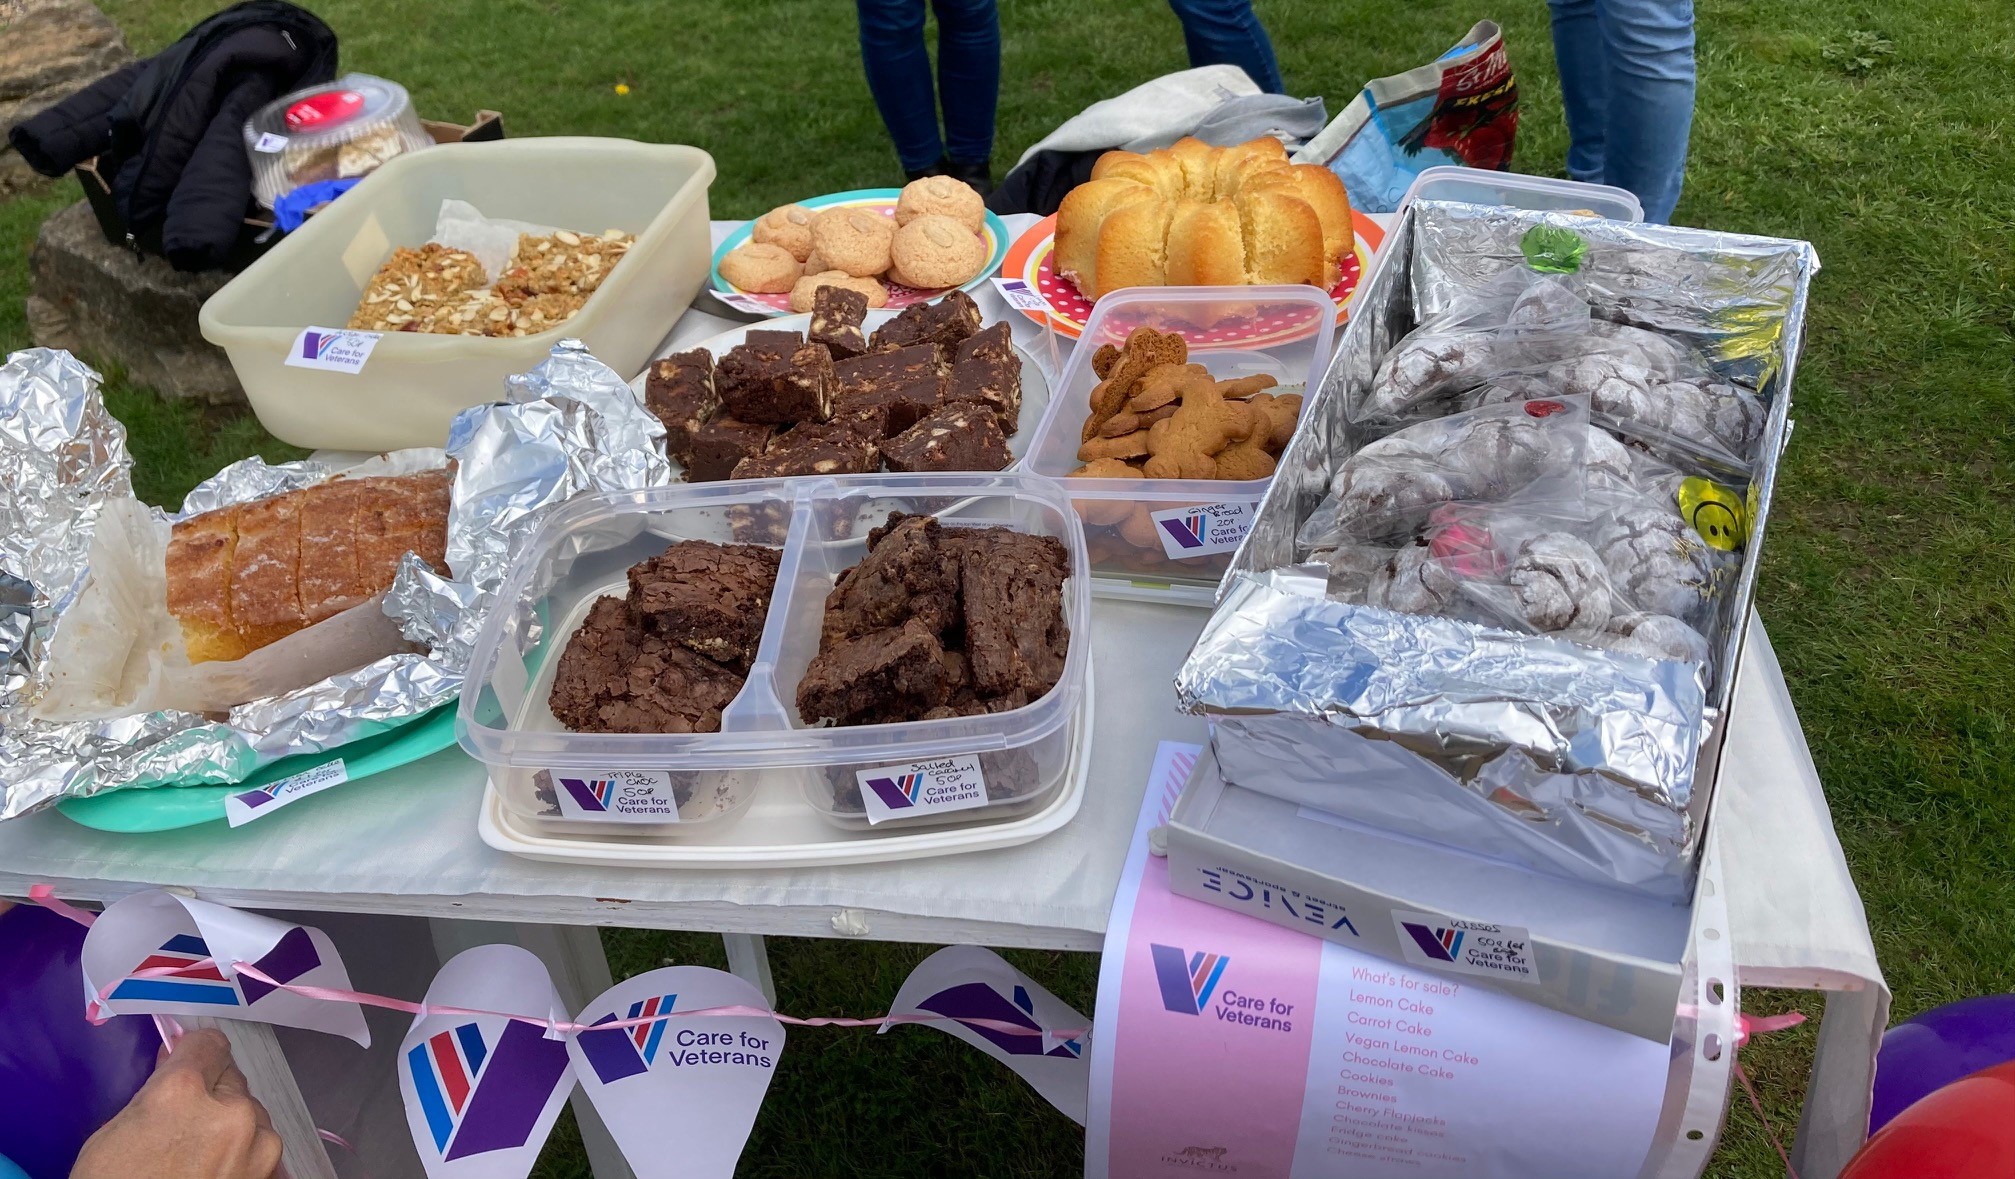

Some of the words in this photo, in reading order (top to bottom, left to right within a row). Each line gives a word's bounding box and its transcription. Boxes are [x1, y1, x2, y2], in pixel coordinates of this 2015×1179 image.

[325, 354, 360, 365] Veterans
[330, 347, 351, 355] Care
[352, 349, 364, 358] for
[1210, 535, 1244, 545] Vetera
[1211, 528, 1237, 537] Care
[286, 773, 339, 793] Veterans
[926, 786, 957, 796] Care
[960, 782, 977, 791] for
[618, 797, 648, 806] Care
[651, 797, 668, 806] for
[924, 791, 980, 804] Veterans
[616, 804, 671, 814] Veterans
[1466, 956, 1529, 974] Veterans
[1468, 948, 1503, 961] Care
[1506, 954, 1526, 965] for
[1352, 966, 1396, 986] What's
[1400, 974, 1420, 990] for
[1423, 981, 1460, 996] sale?
[1222, 990, 1265, 1011] Care
[1269, 997, 1294, 1016] for
[1350, 989, 1393, 1008] Lemon
[1398, 997, 1434, 1015] Cake
[1215, 1005, 1292, 1032] Veterans
[1347, 1011, 1392, 1029] Carrot
[1396, 1020, 1432, 1036] Cake
[676, 1030, 733, 1047] Care
[739, 1031, 769, 1050] for
[1345, 1031, 1389, 1049] Vegan
[1394, 1040, 1438, 1058] Lemon
[1442, 1049, 1479, 1065] Cake
[669, 1049, 771, 1068] Veterans
[1342, 1051, 1413, 1072] Chocolate
[1418, 1064, 1454, 1080] Cake
[1340, 1069, 1394, 1086] Cookies
[1338, 1085, 1397, 1103] Brownies
[1333, 1114, 1402, 1131] Chocolate
[1336, 1101, 1379, 1117] Cherry
[1384, 1108, 1446, 1127] Flapjacks
[1331, 1126, 1372, 1138] Fridge
